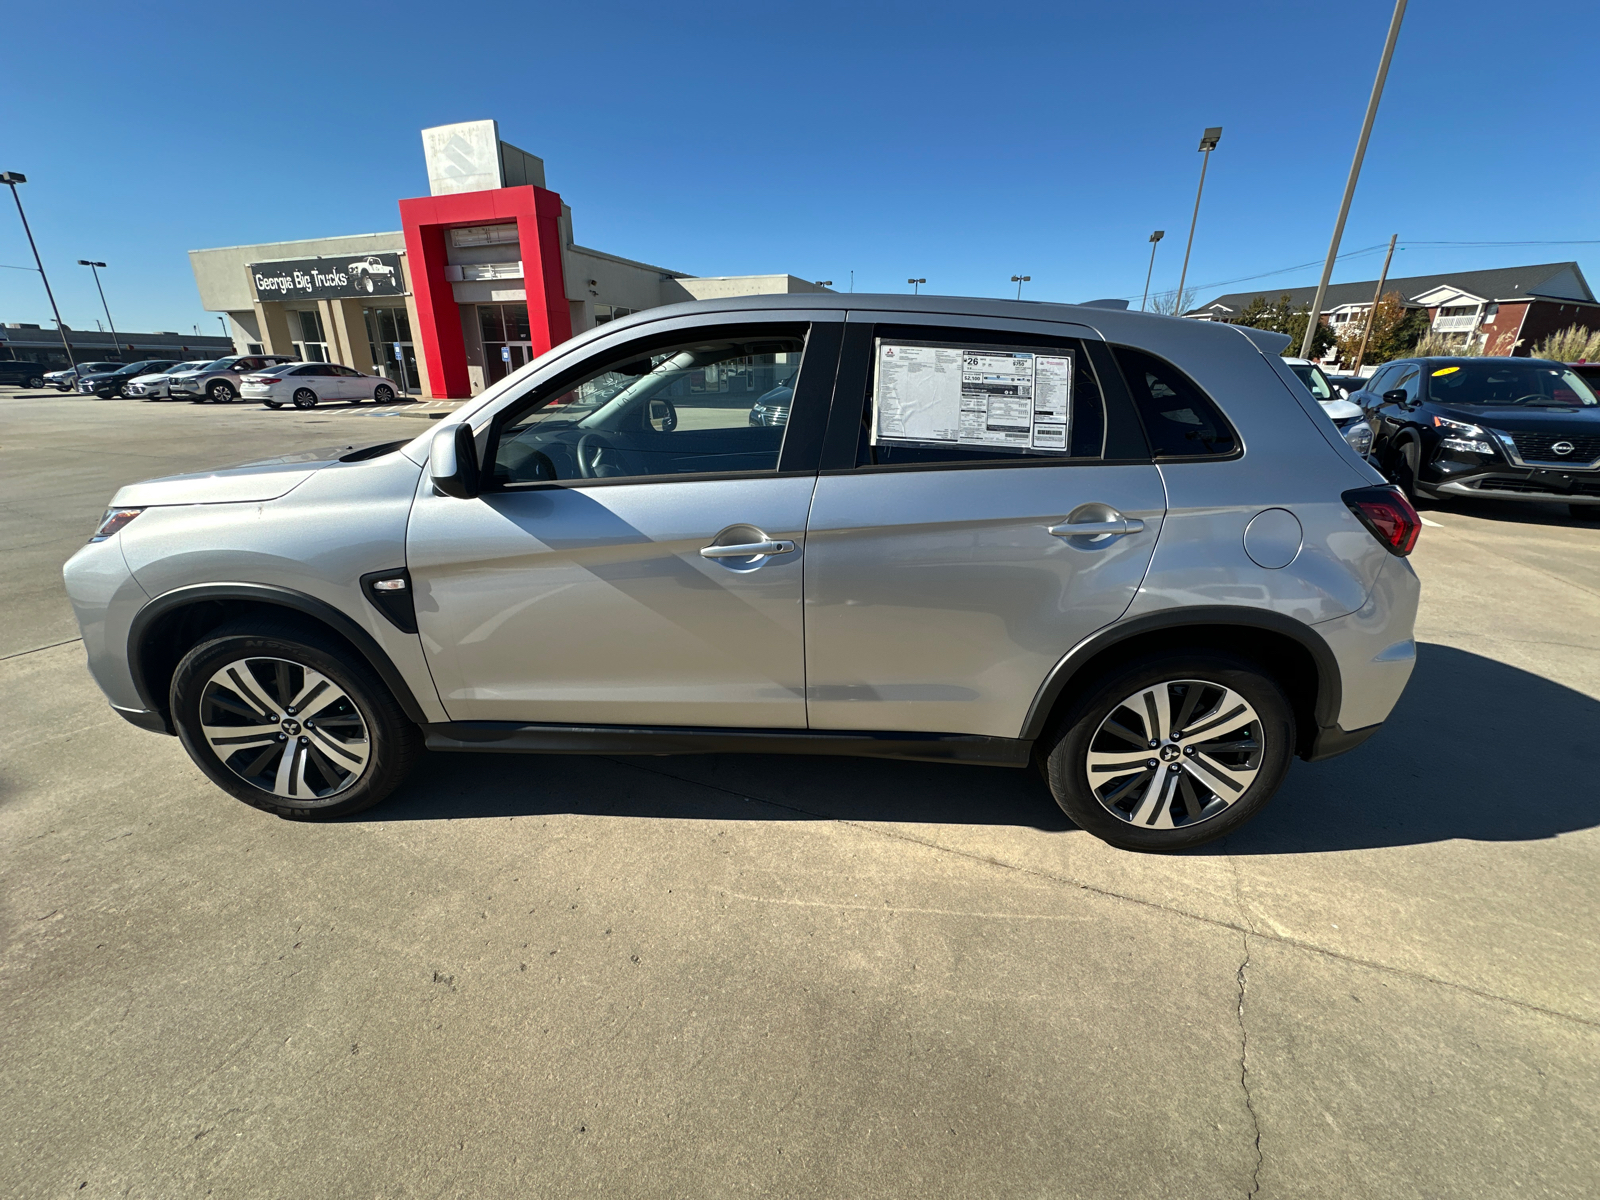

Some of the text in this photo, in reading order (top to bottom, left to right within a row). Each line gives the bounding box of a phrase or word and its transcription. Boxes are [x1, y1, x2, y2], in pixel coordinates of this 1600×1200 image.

[255, 269, 347, 294] Georgia Big Trucks
[967, 357, 979, 366] 26
